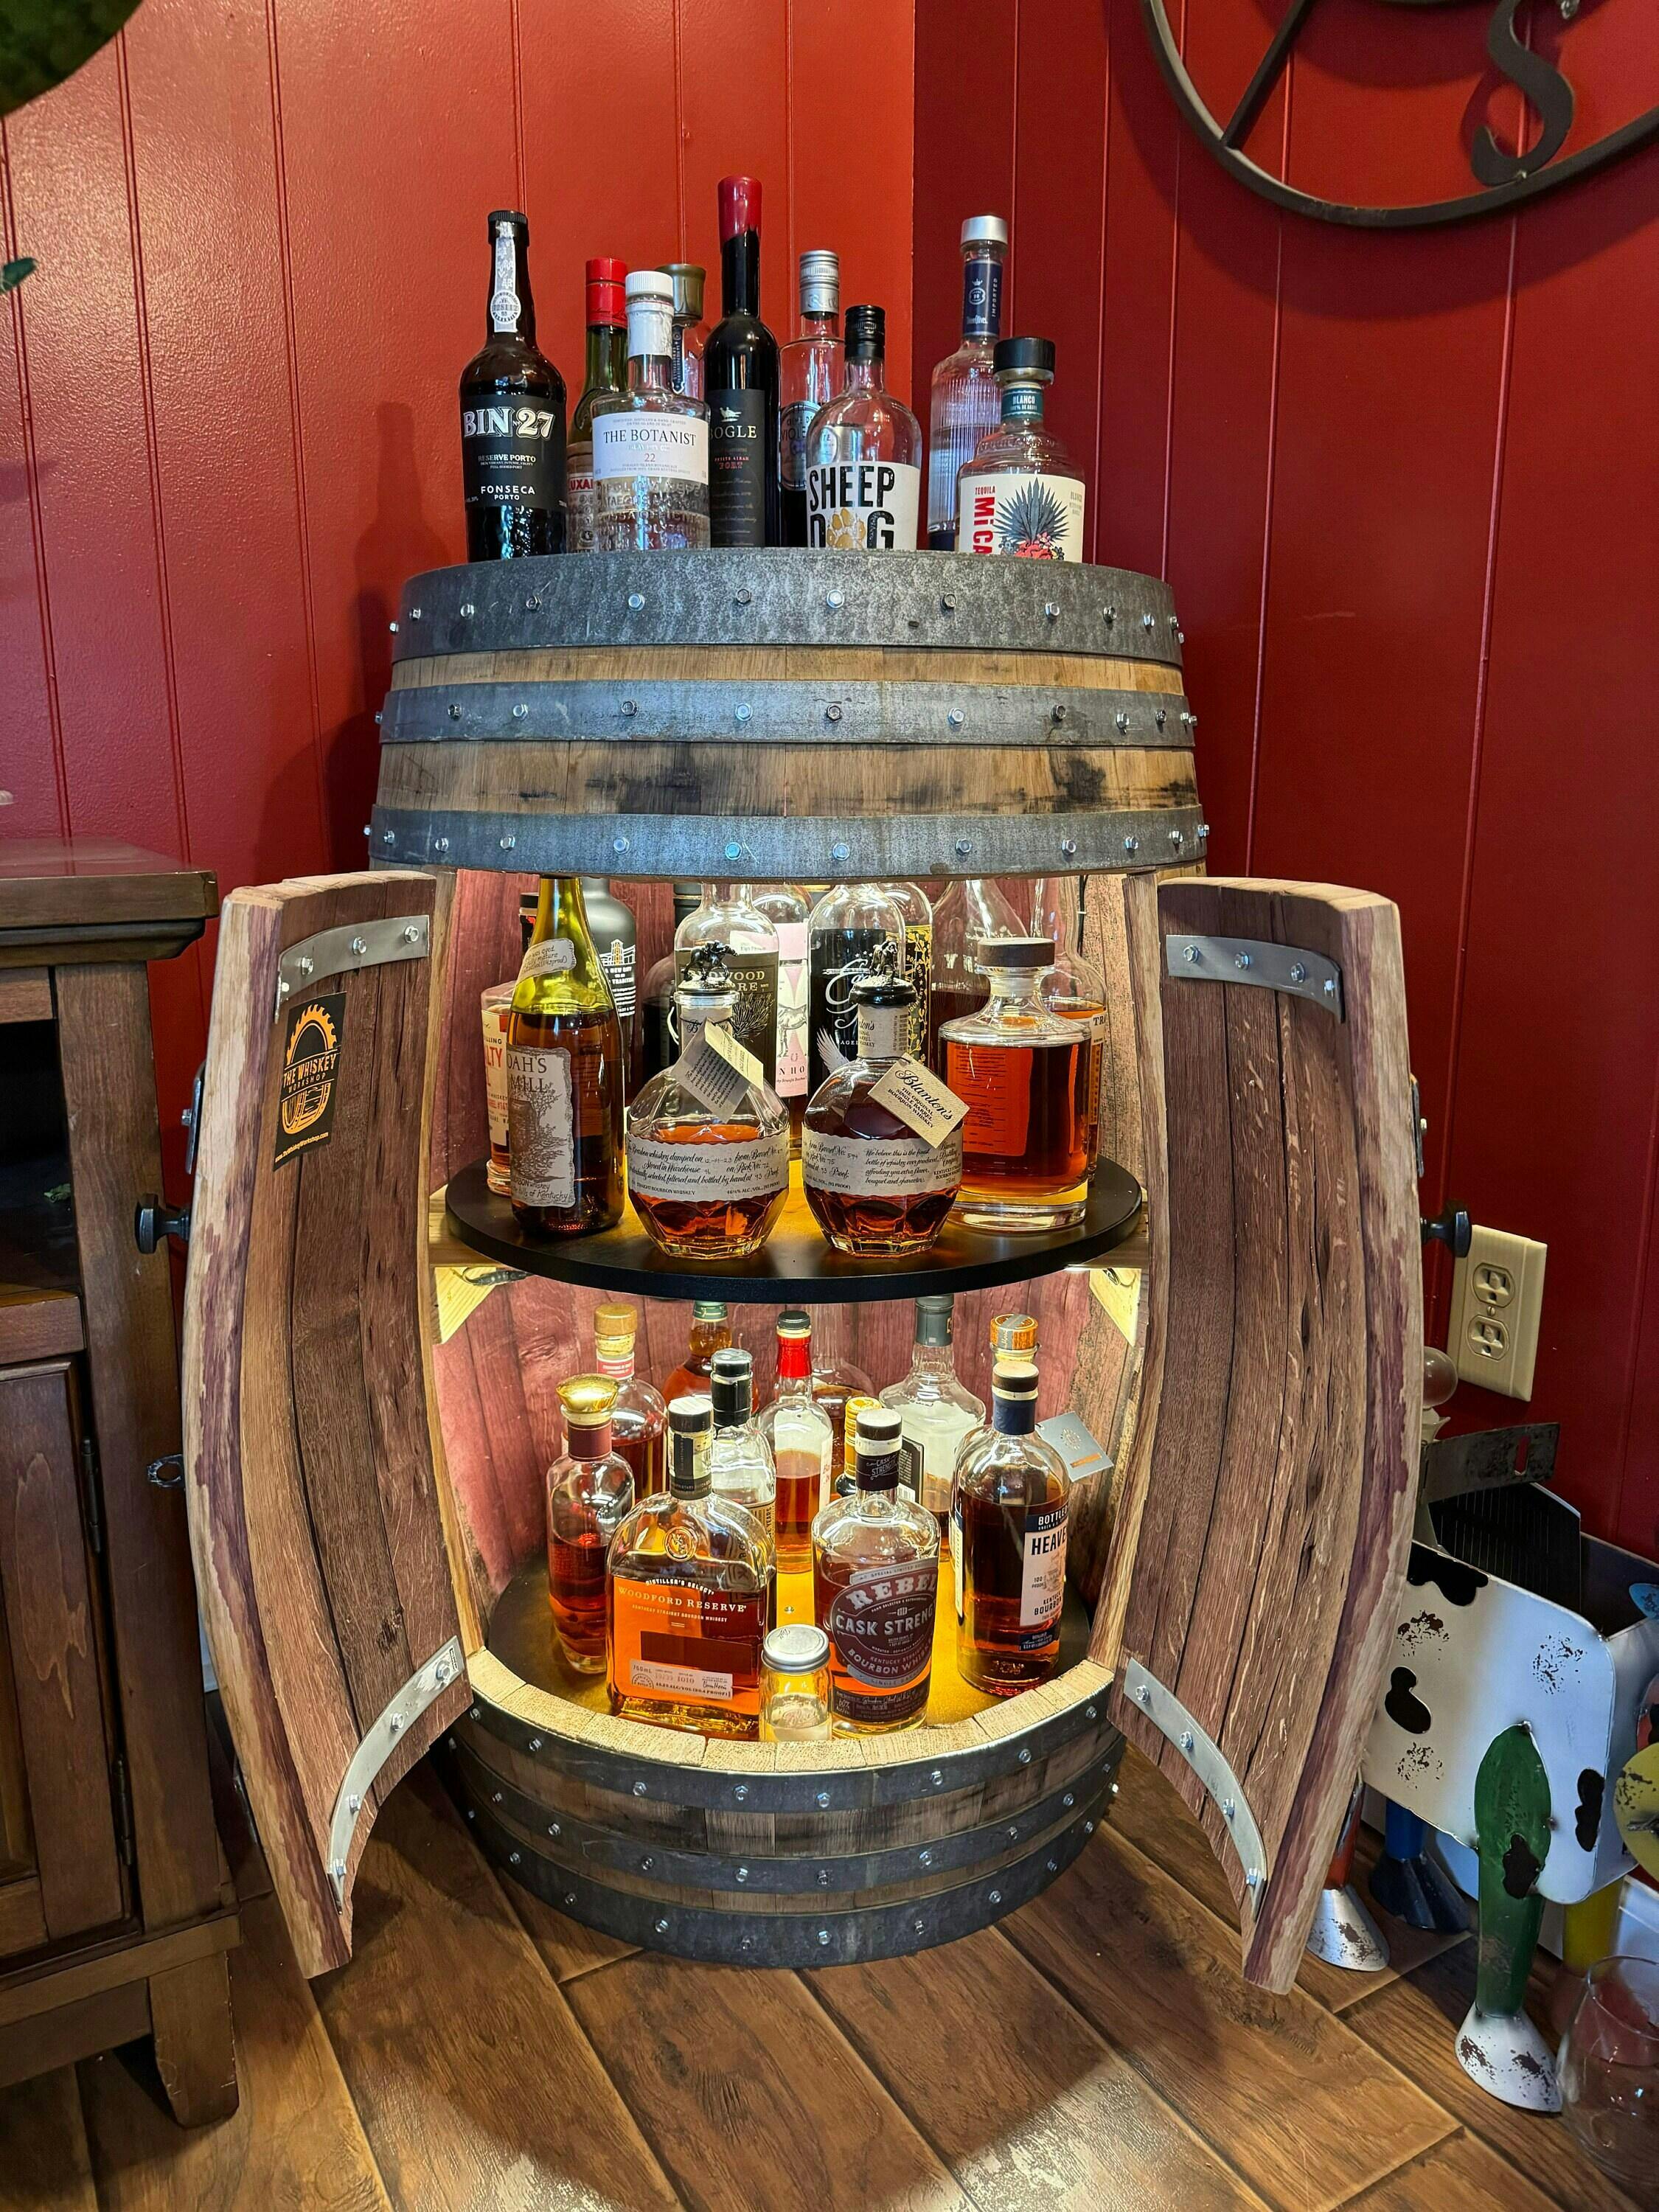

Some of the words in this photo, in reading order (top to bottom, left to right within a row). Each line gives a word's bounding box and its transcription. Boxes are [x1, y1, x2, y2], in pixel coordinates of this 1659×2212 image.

[1012, 395, 1035, 404] BLANCO
[464, 406, 515, 437] BIN
[516, 408, 555, 440] 27
[604, 430, 626, 444] THE
[631, 429, 697, 446] BOTANIST
[510, 454, 536, 462] PORTO
[644, 453, 655, 462] 22
[481, 485, 535, 495] FONSECA
[810, 466, 895, 512] SHEEP
[975, 486, 995, 495] TEQUILA
[810, 510, 894, 549] DG
[283, 1069, 296, 1088] THE
[298, 1054, 337, 1079] WHISKEY
[507, 1054, 547, 1073] OAH'S
[288, 1072, 326, 1093] WORKSHOP
[895, 1070, 953, 1120] Blanton's
[902, 1088, 911, 1097] THE
[911, 1095, 933, 1116] ORIGINAL
[888, 1088, 912, 1110] BOURBON
[913, 1108, 934, 1127] WHISKEY
[896, 1089, 914, 1105] SINGLE
[914, 1103, 933, 1121] BARREL
[669, 1152, 694, 1163] dumped
[734, 1152, 751, 1164] from
[887, 1159, 906, 1167] whiskey
[667, 1163, 700, 1174] Warehouse
[866, 1168, 891, 1177] affording
[891, 1169, 900, 1178] you
[700, 1174, 721, 1183] bottled
[729, 1174, 745, 1183] hand
[866, 1178, 886, 1186] bouquet
[538, 1189, 568, 1203] Kentucky
[877, 1456, 891, 1467] CASK
[1032, 1526, 1066, 1556] HEAVE
[646, 1578, 685, 1586] DISTILLER'S
[687, 1581, 712, 1595] SELECT
[619, 1586, 682, 1605] WOODFORD
[687, 1599, 745, 1613] RESERVE
[1034, 1596, 1062, 1615] BOURBON
[632, 1604, 655, 1613] KENTUCKY
[656, 1609, 680, 1618] STRAIGHT
[681, 1613, 703, 1621] BOURBON
[835, 1614, 878, 1636] CASK
[884, 1604, 933, 1635] STRENG
[848, 1649, 898, 1674] BOURBON
[870, 1656, 901, 1665] KENTUCKY
